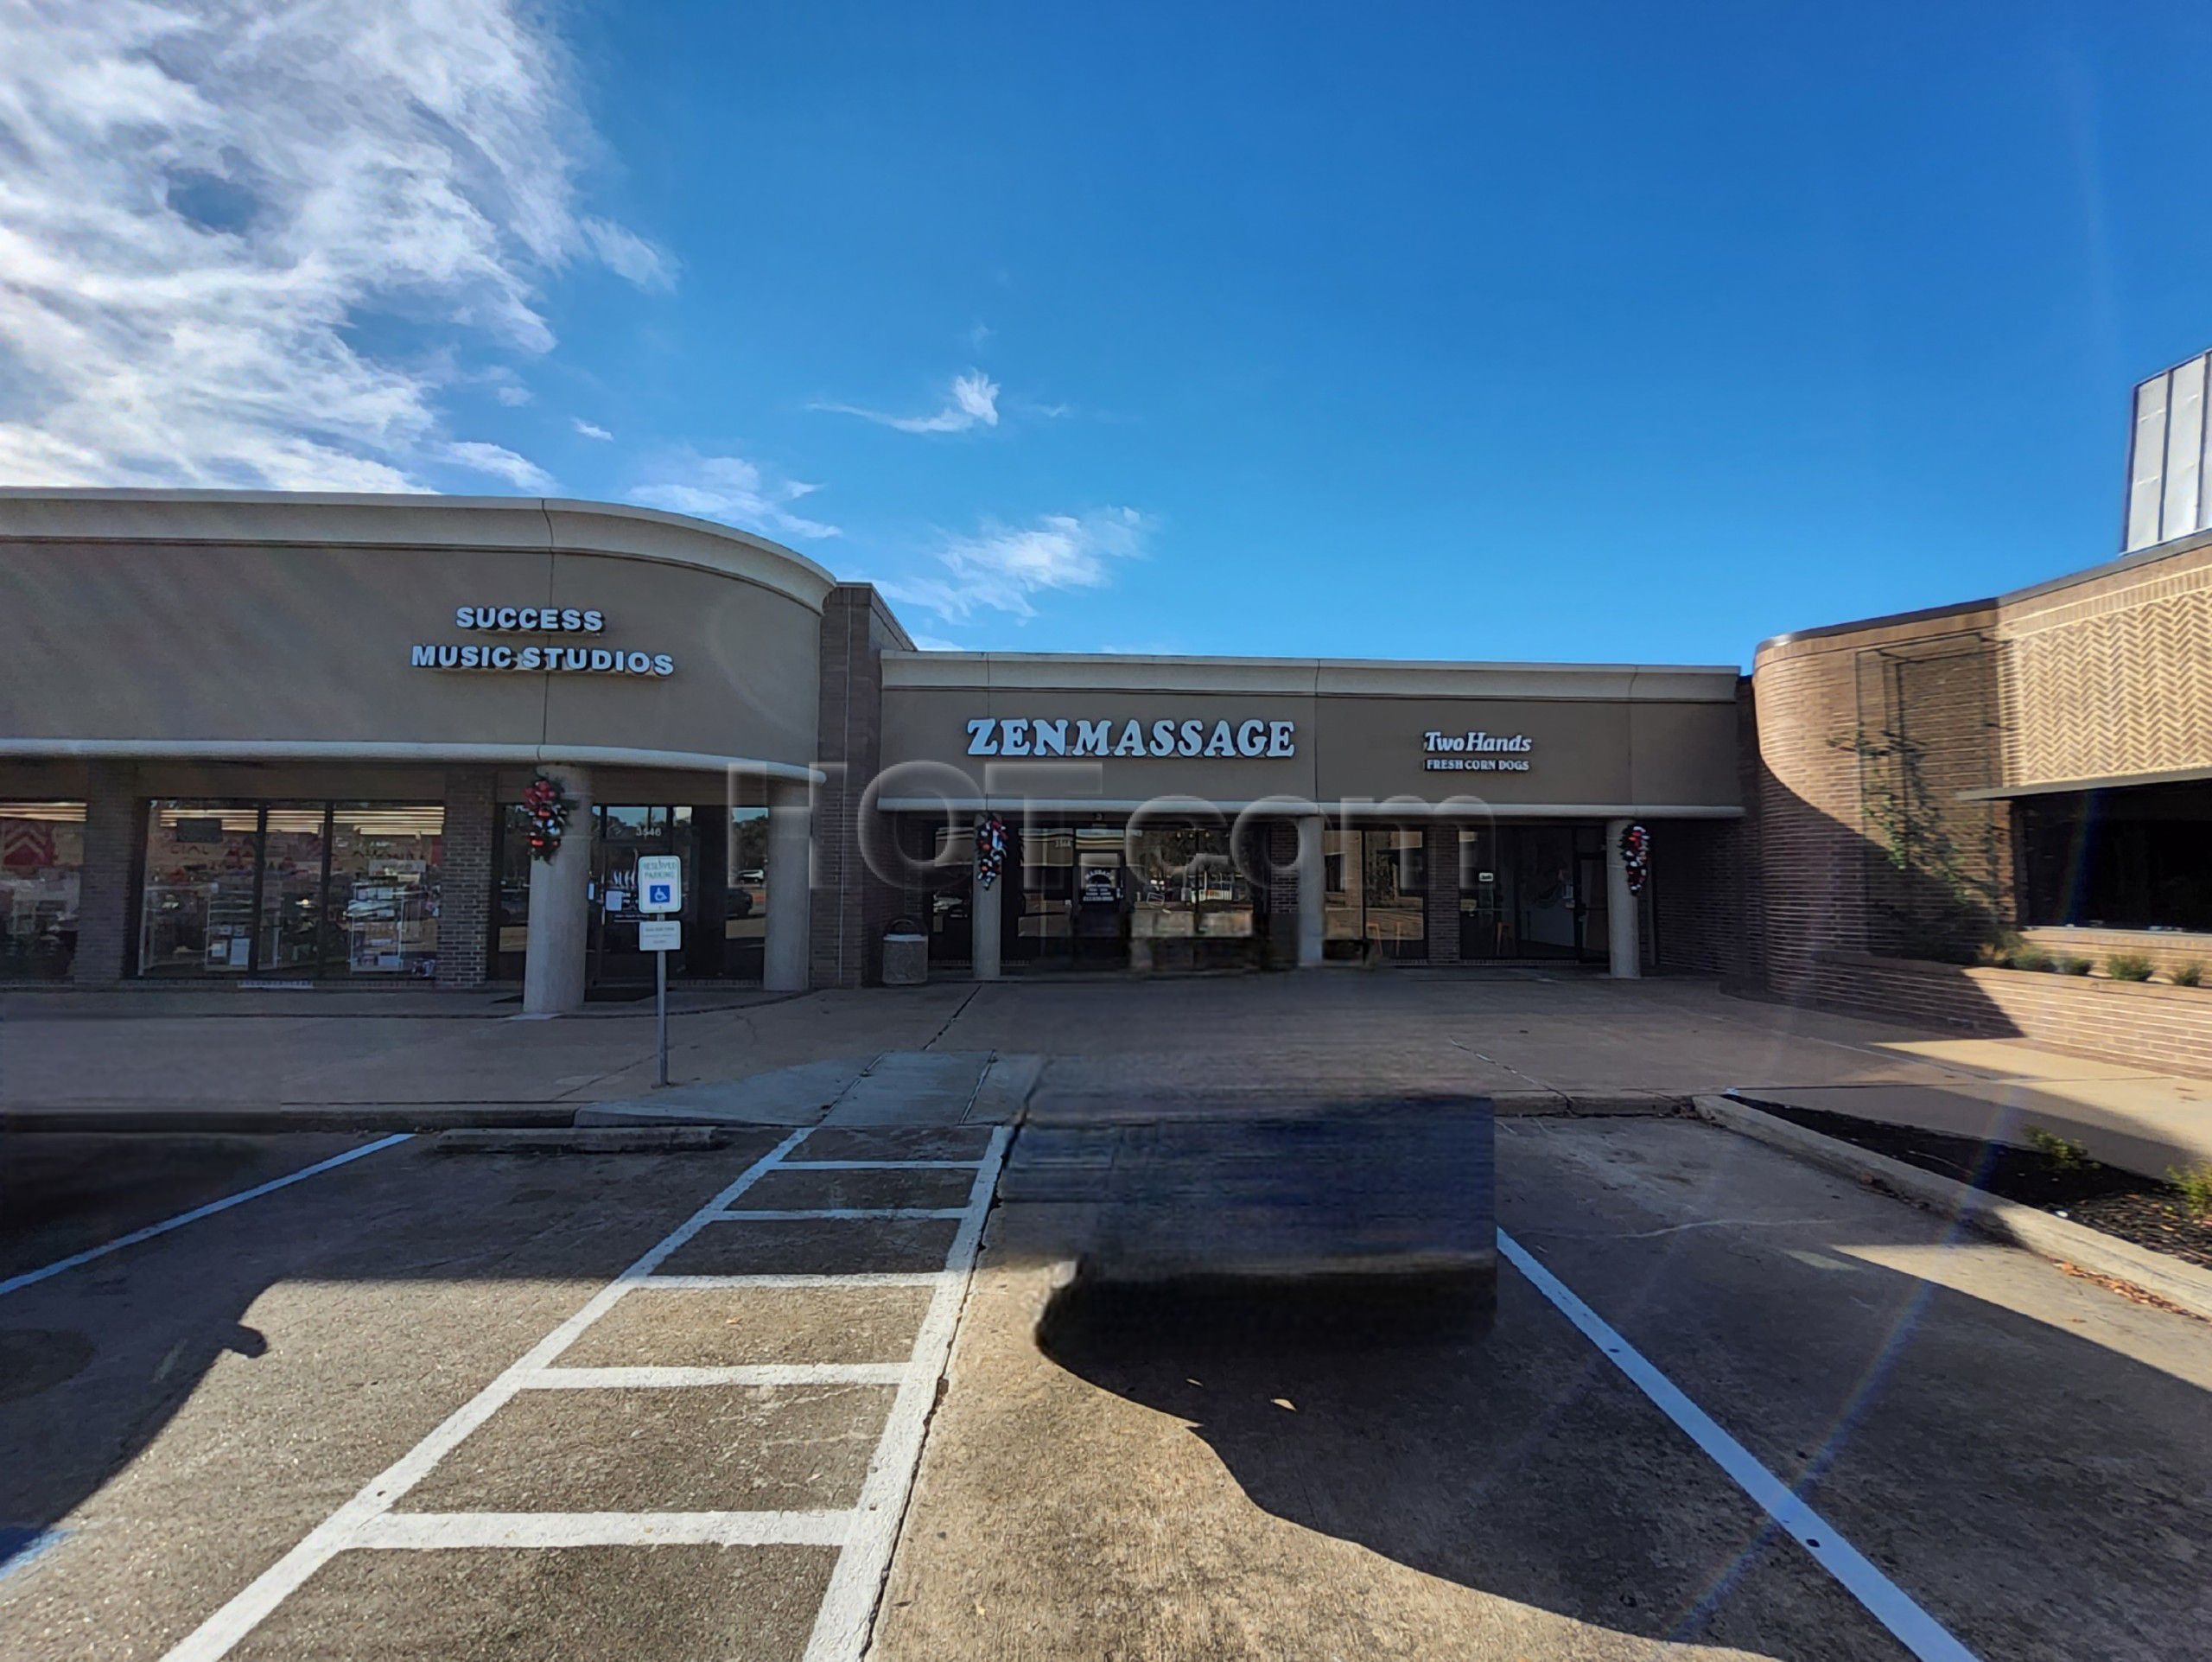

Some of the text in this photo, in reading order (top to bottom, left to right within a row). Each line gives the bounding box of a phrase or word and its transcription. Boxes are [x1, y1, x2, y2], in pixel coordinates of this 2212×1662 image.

[456, 606, 603, 631] SUCCESS
[410, 645, 674, 676] MUSIC STUDIOS
[1424, 730, 1533, 752] Two Hands
[1426, 759, 1530, 771] FRESH CORN DOGS
